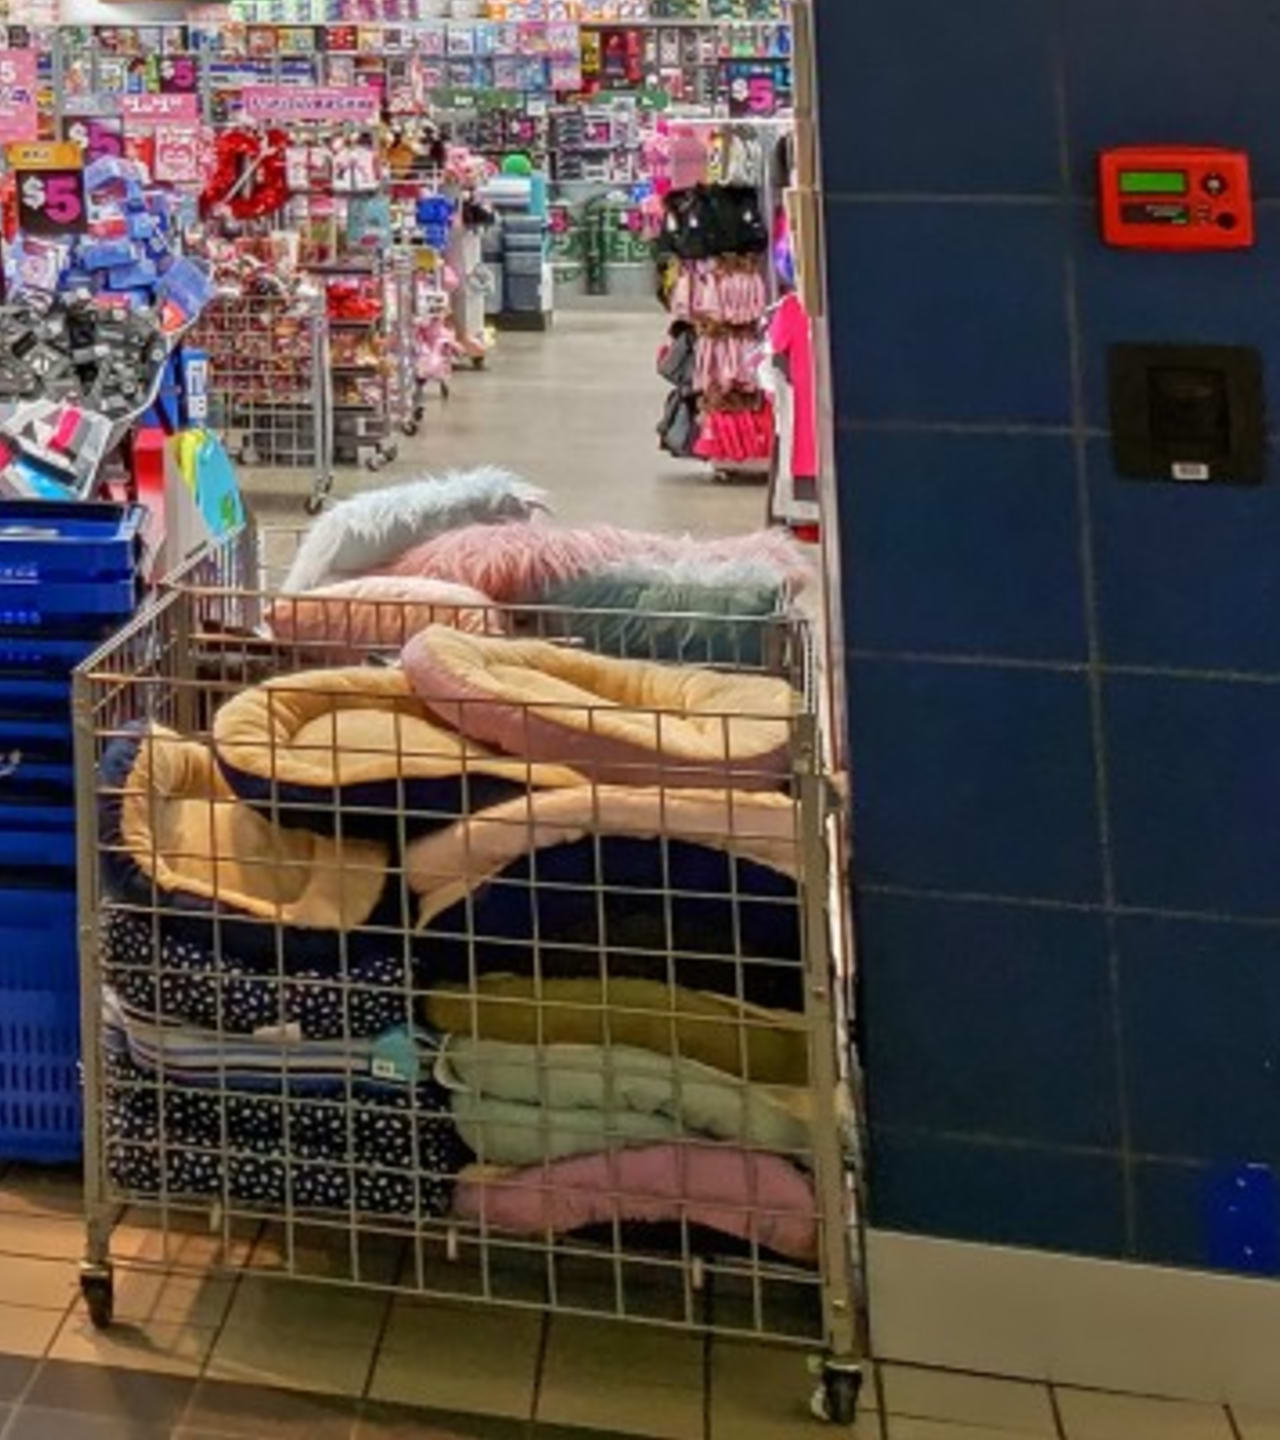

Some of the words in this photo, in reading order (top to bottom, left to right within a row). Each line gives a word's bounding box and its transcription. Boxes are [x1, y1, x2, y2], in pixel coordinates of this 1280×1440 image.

[162, 56, 197, 88] $5
[731, 77, 774, 110] $5
[68, 121, 124, 160] $5
[22, 175, 82, 224] $5
